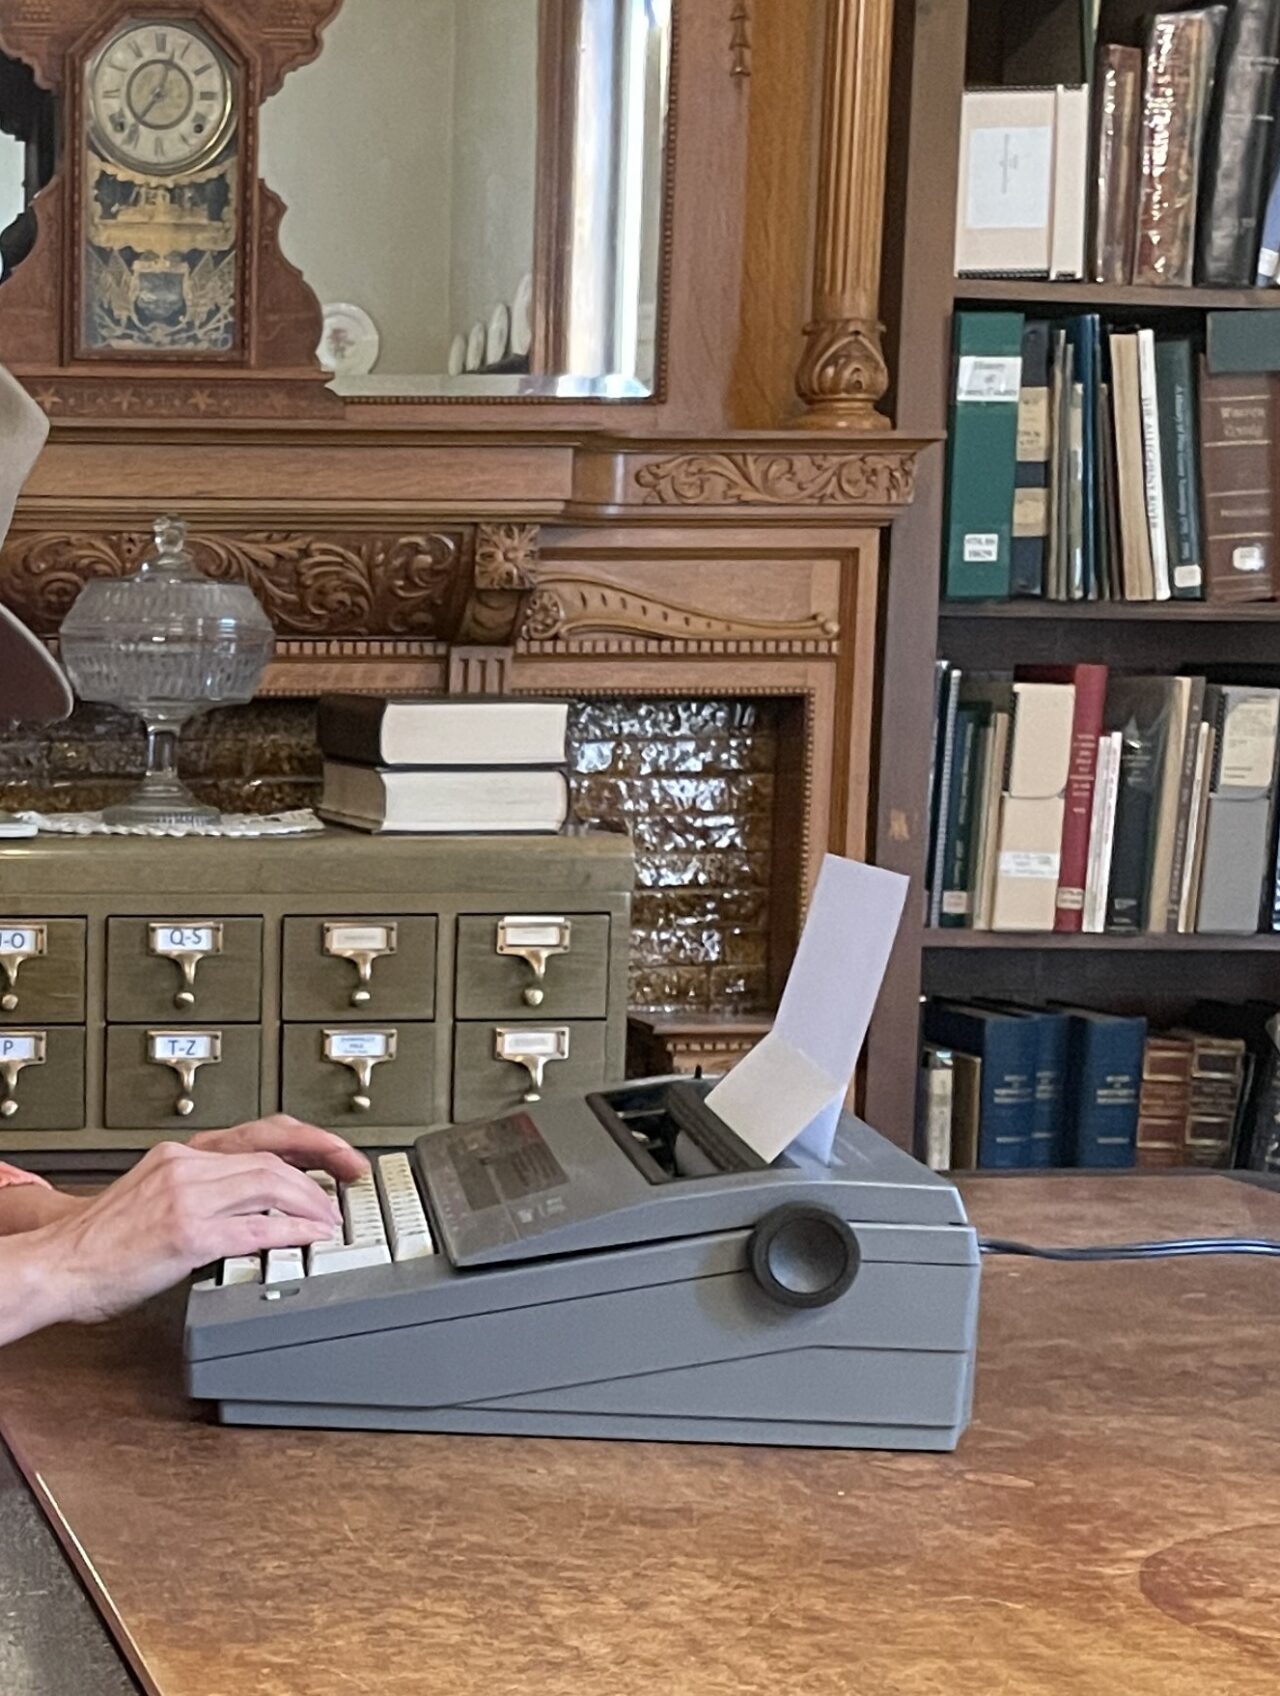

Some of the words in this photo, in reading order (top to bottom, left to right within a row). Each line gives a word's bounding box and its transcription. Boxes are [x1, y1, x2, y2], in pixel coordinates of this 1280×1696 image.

[169, 928, 203, 946] Q-S
[2, 1039, 14, 1056] P
[167, 1039, 196, 1056] T-Z
